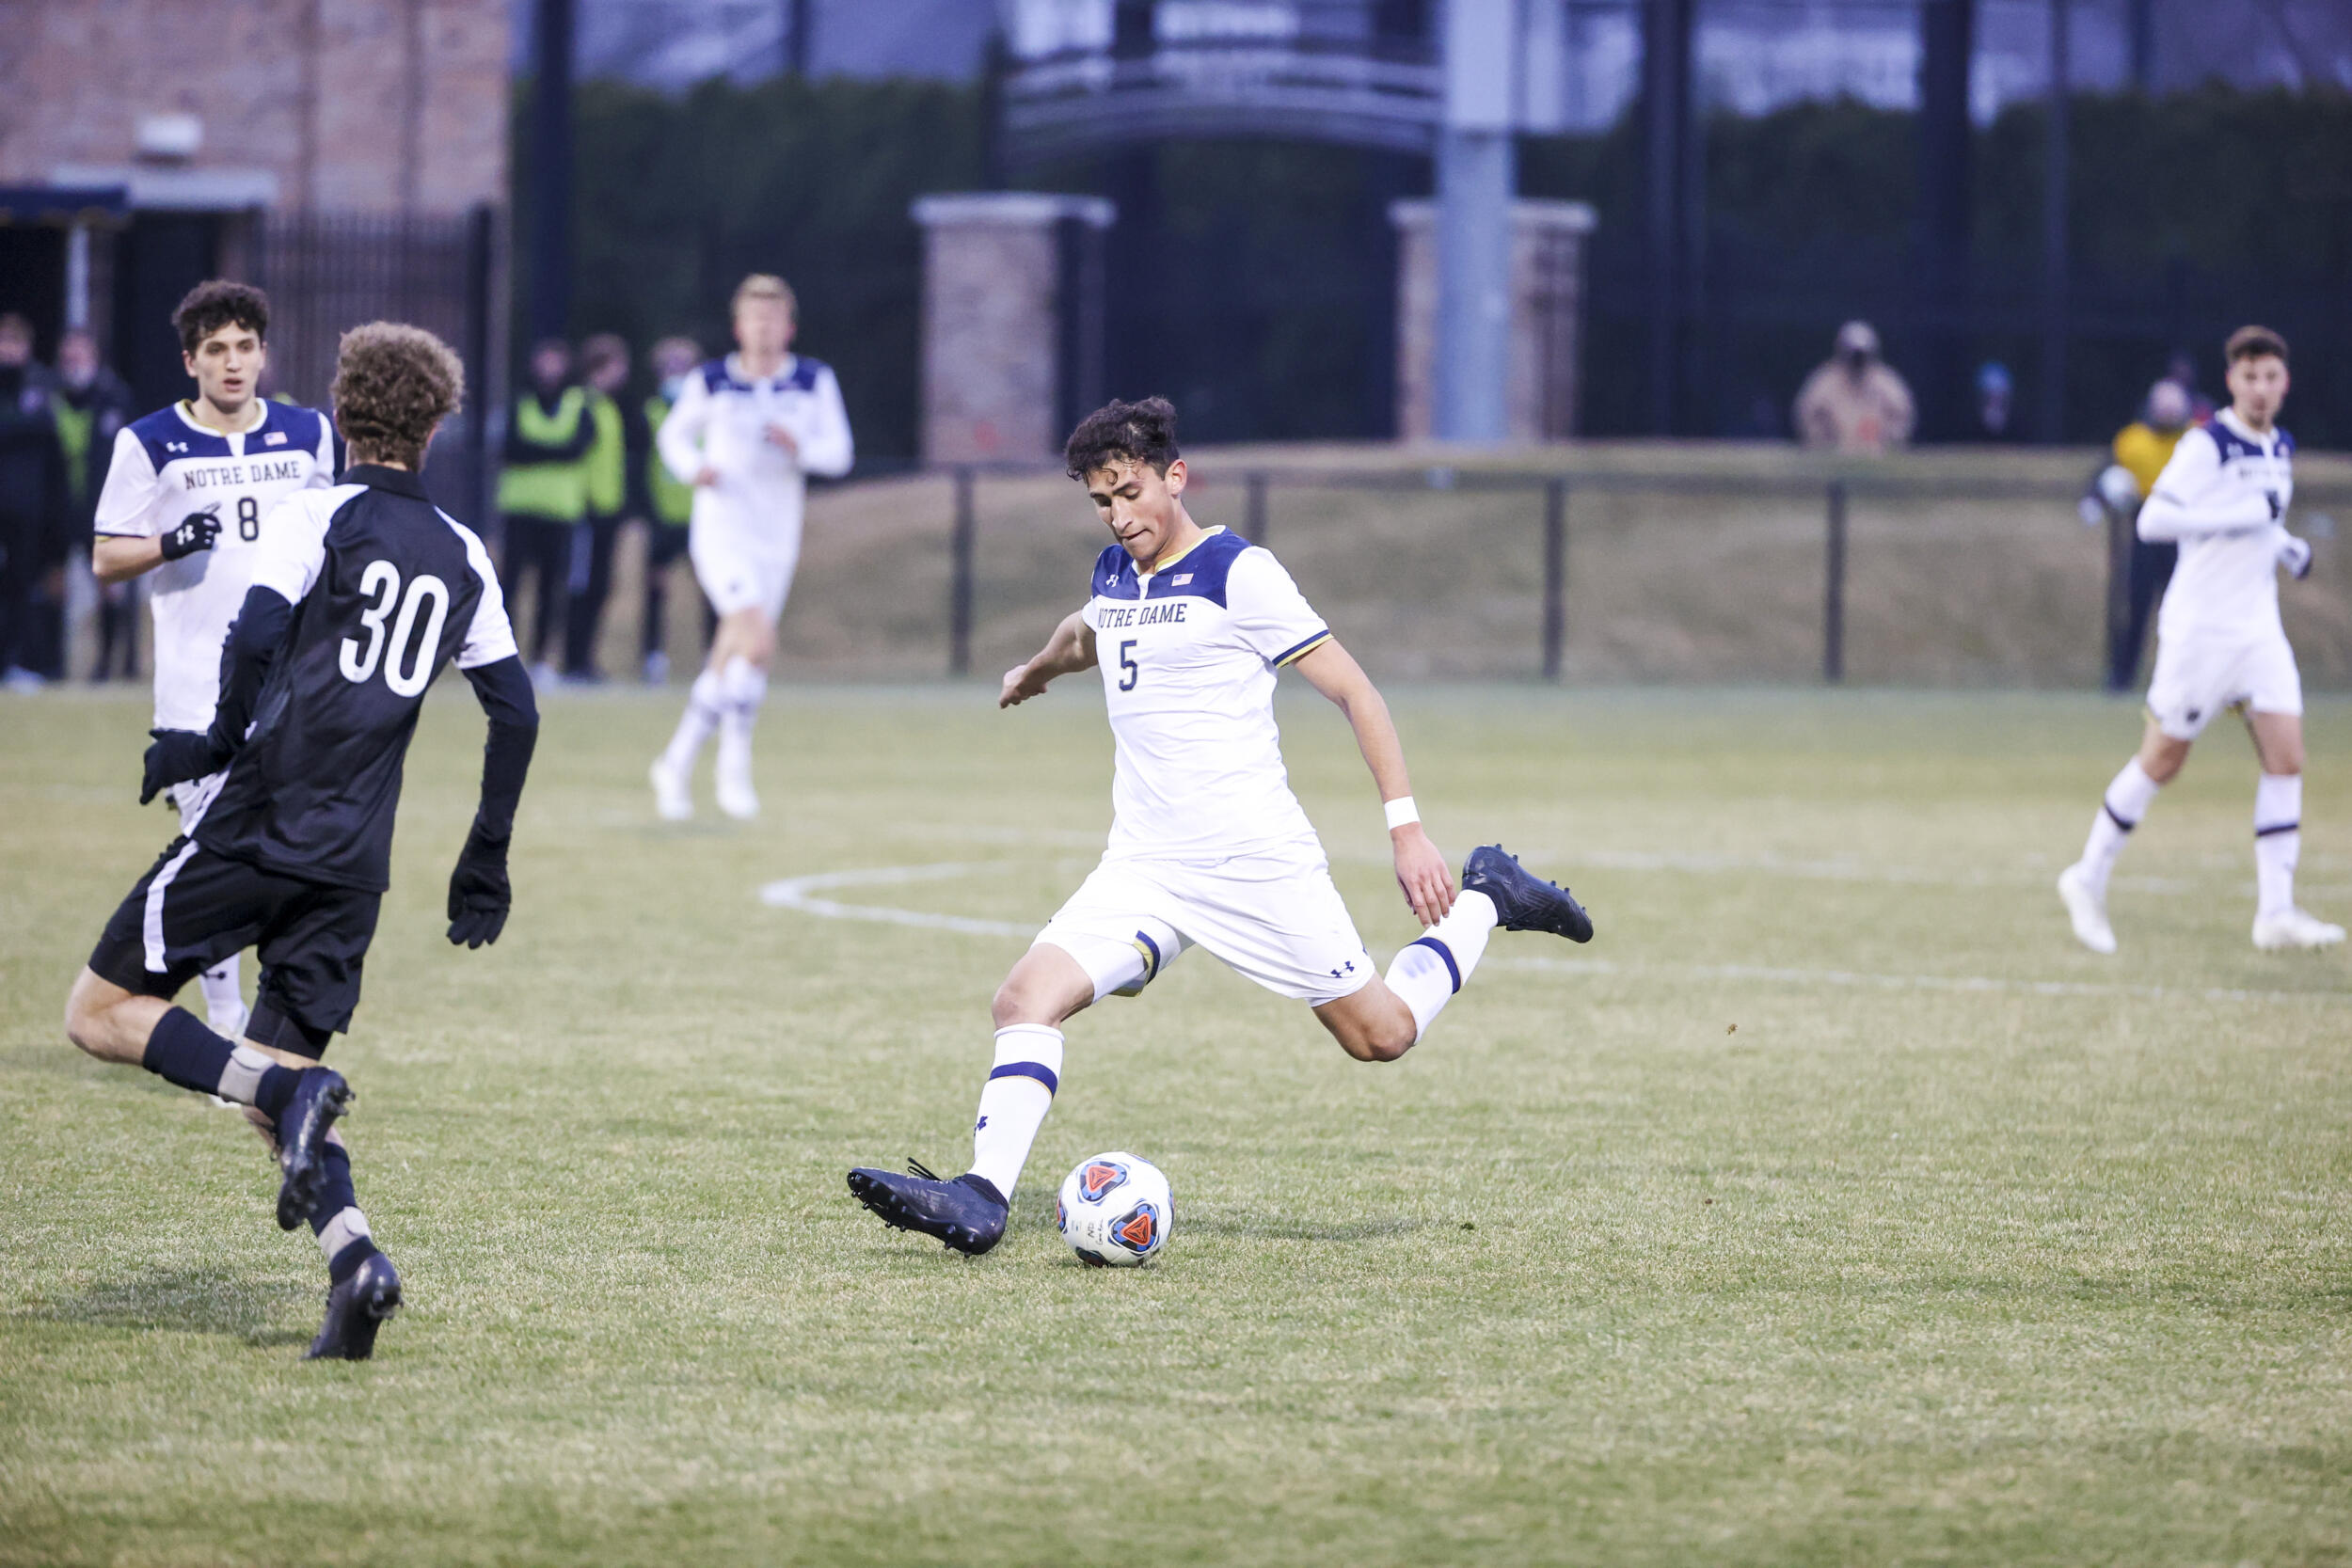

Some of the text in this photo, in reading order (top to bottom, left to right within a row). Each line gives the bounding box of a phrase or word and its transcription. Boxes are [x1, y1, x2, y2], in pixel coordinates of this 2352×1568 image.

[184, 461, 301, 489] NOTRE DAME
[238, 497, 259, 542] 8
[339, 560, 450, 698] 30
[1138, 604, 1187, 626] DAME
[1119, 640, 1138, 691] 5
